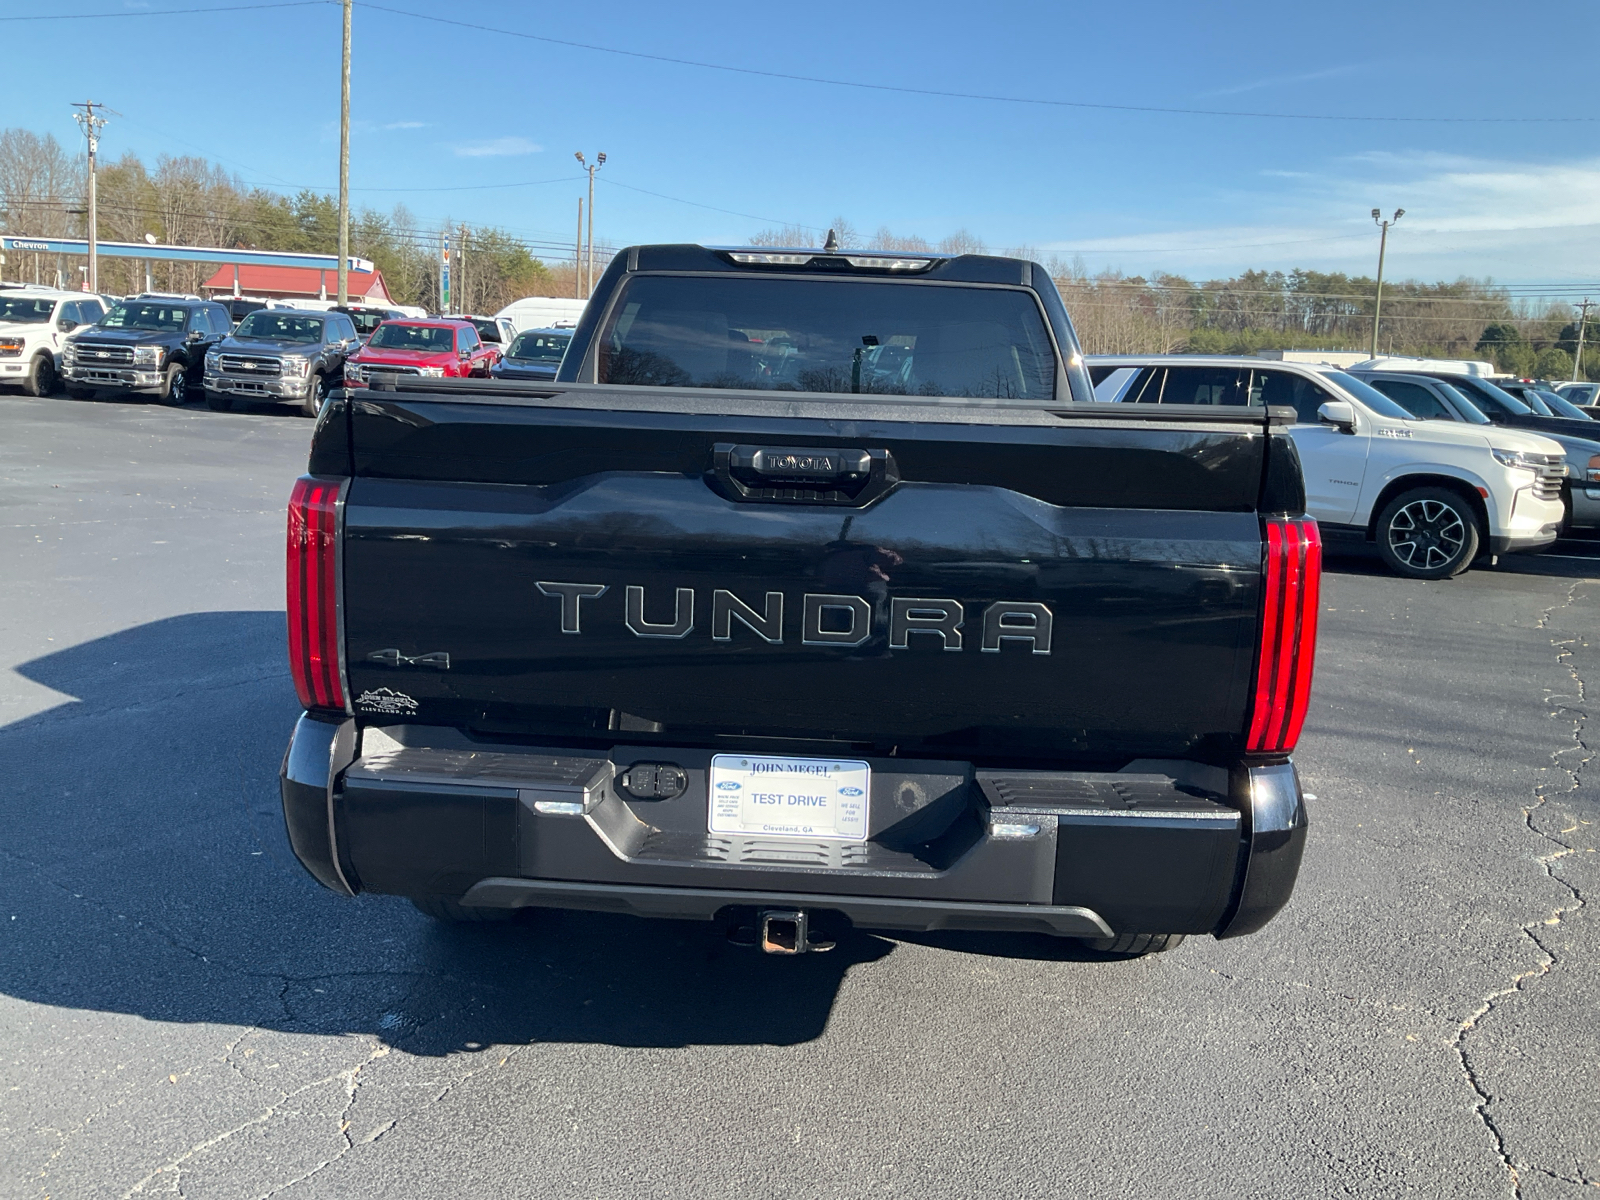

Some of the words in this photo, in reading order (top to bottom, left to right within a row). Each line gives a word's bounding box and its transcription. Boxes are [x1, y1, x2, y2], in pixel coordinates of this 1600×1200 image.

[12, 240, 49, 250] Chevron
[768, 455, 832, 471] TOYOTA
[1328, 479, 1359, 487] TAHOE
[534, 581, 1054, 655] TUNDRA
[750, 762, 784, 776] JOHN
[786, 764, 831, 778] MEGEL
[751, 793, 784, 805] TEST
[787, 794, 827, 807] DRIVE
[763, 824, 801, 834] Cleveland,
